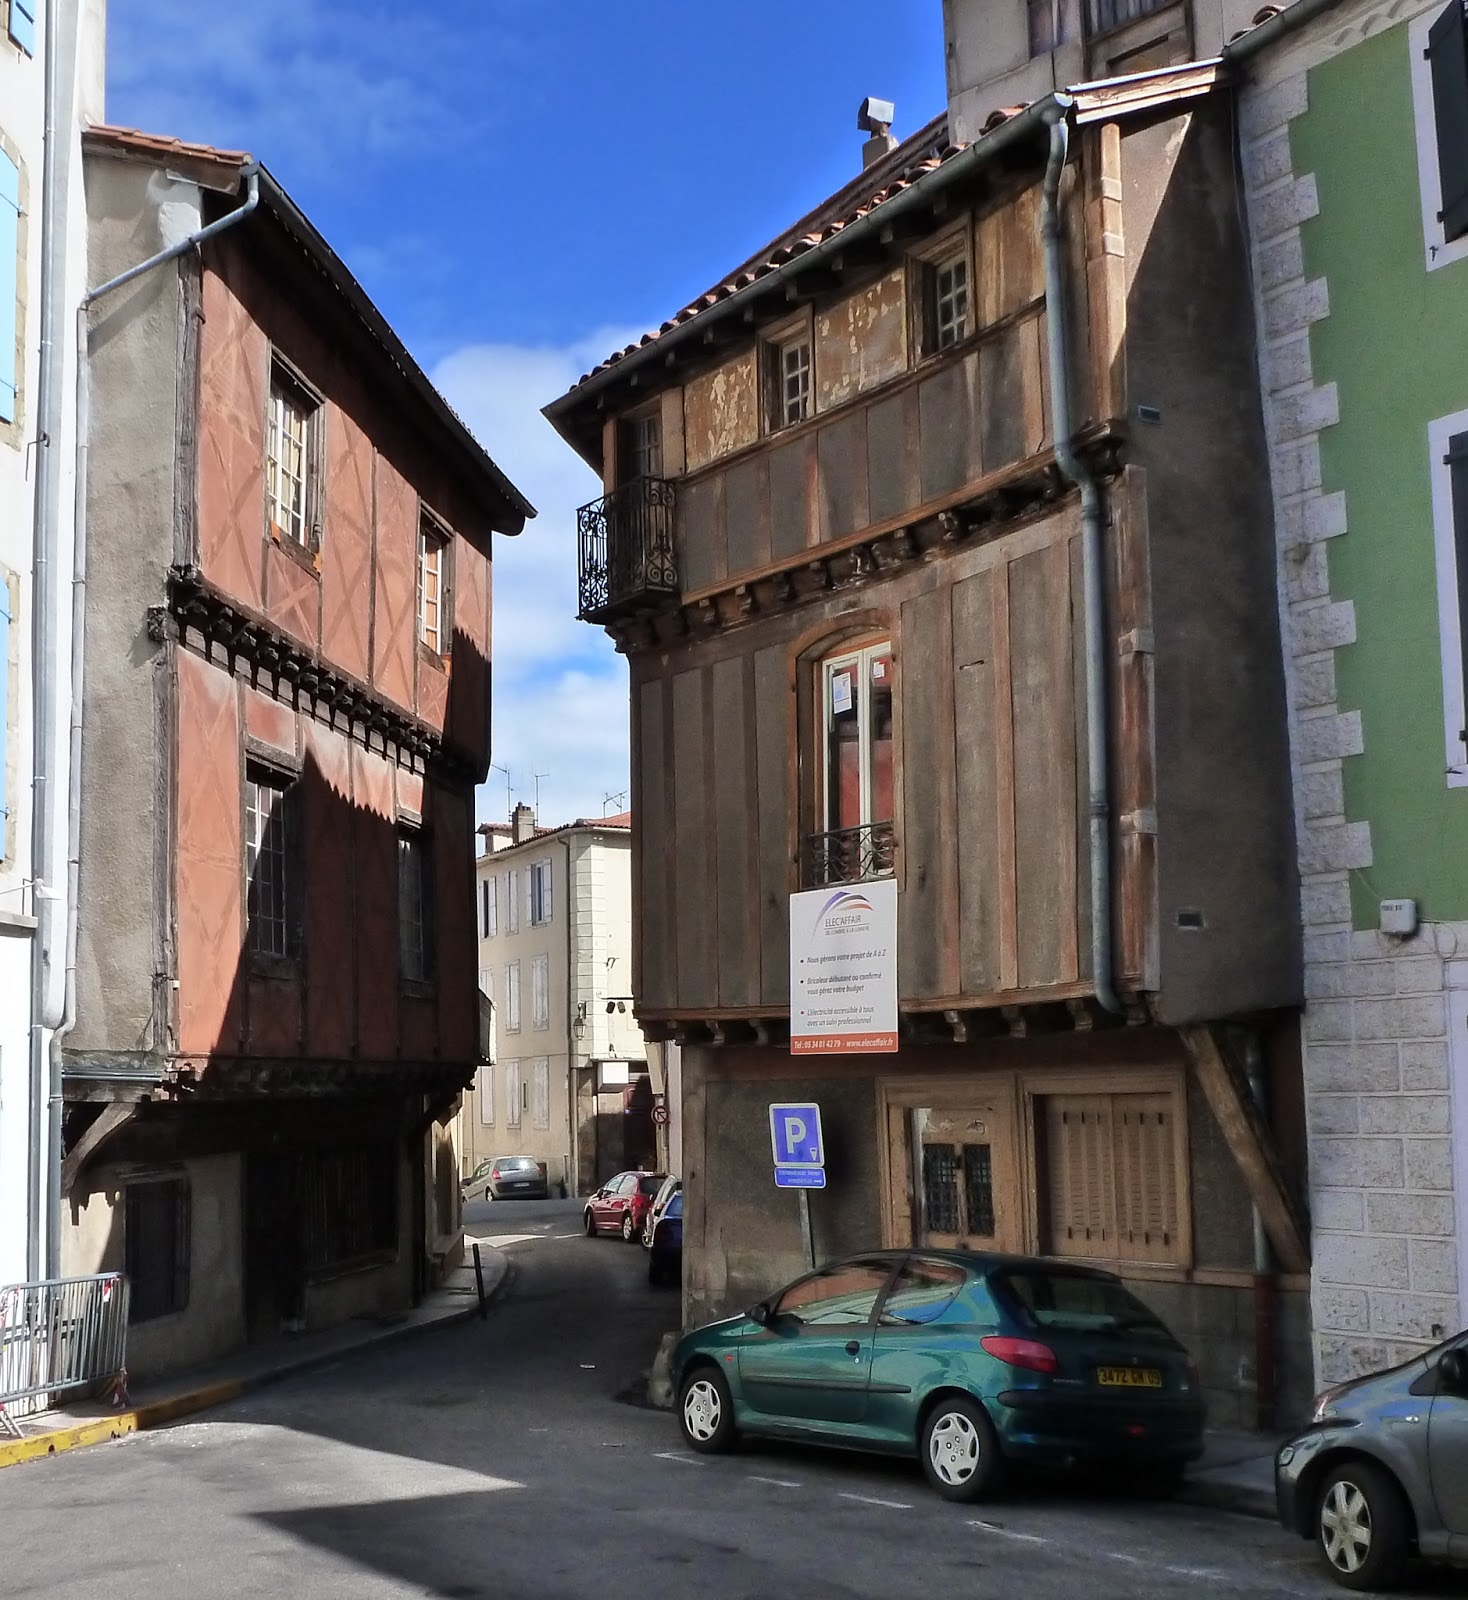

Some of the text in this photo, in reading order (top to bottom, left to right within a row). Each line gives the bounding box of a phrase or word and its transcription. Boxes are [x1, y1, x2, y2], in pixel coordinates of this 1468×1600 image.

[850, 952, 866, 962] projet
[807, 977, 828, 985] Bricoleur
[829, 975, 851, 983] débutant
[846, 985, 864, 994] budget
[833, 1006, 858, 1015] accessible
[826, 1018, 837, 1026] suivi
[837, 1016, 872, 1026] professionnel
[784, 1117, 807, 1154] P
